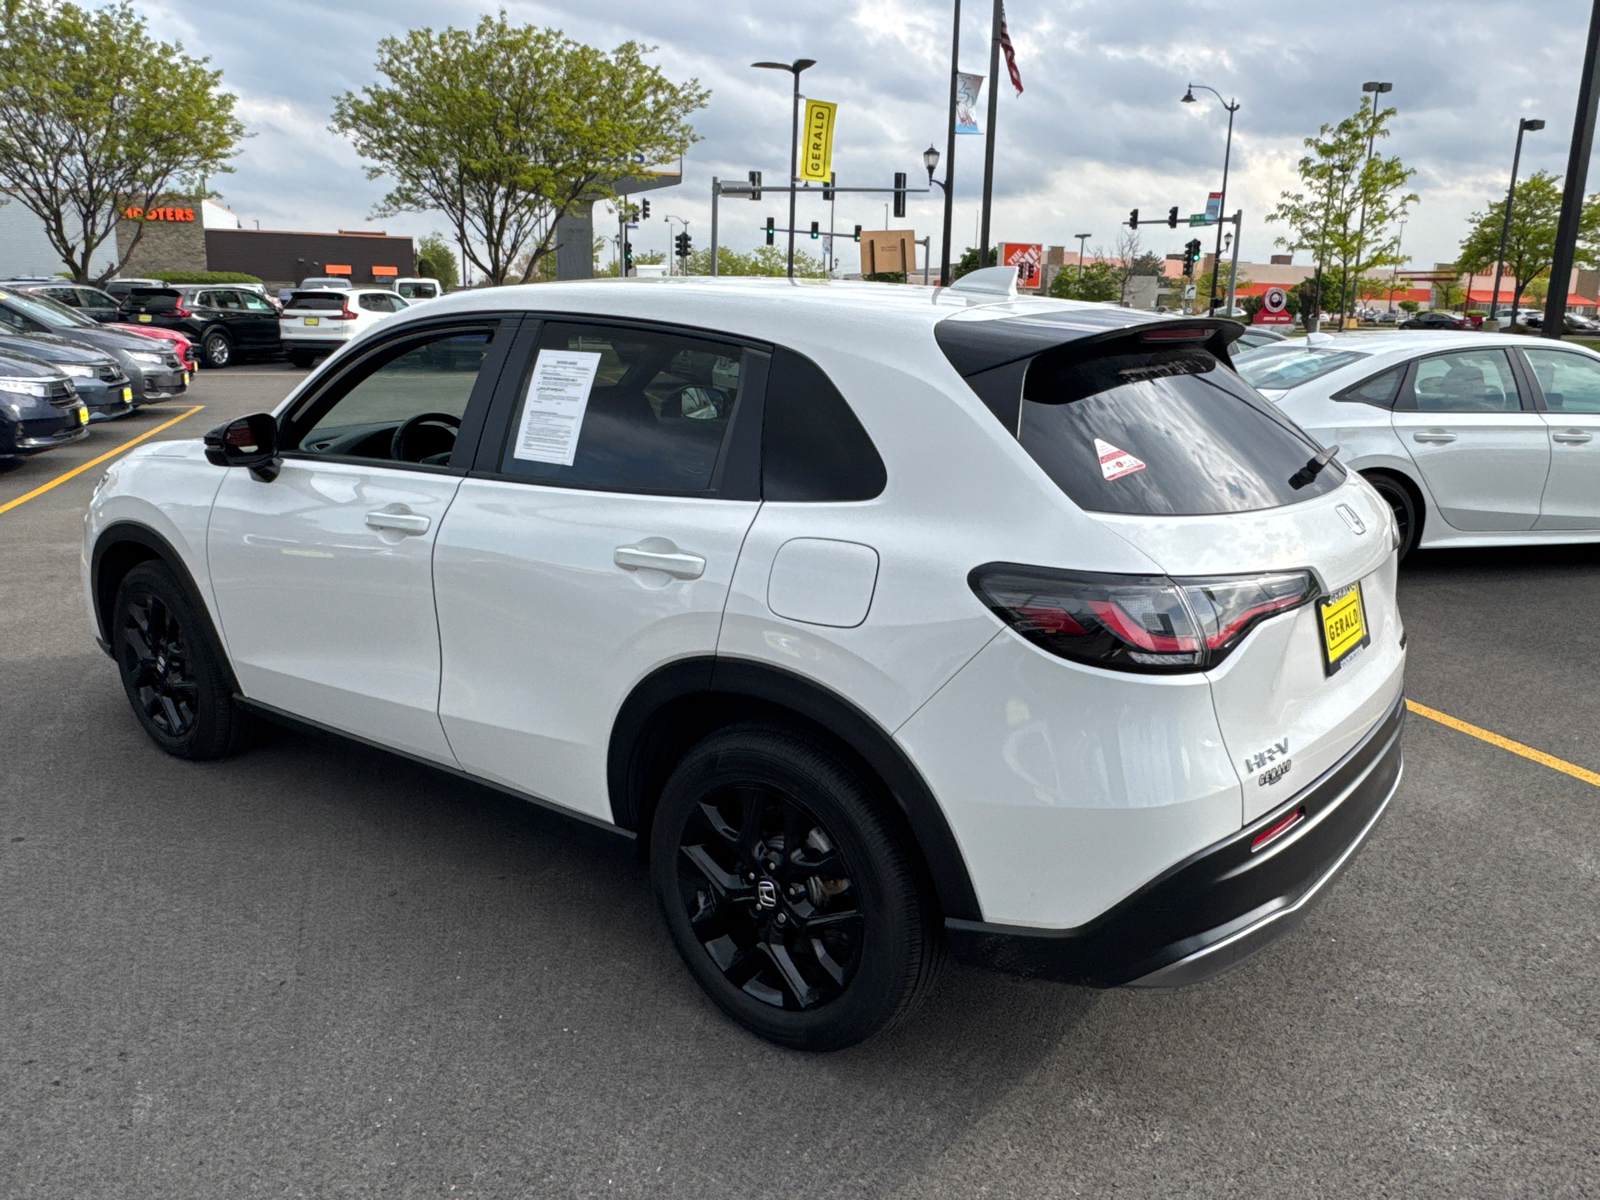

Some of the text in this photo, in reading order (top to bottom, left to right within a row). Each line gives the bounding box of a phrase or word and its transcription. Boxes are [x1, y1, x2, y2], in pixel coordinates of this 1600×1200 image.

[811, 111, 825, 172] GERALD
[1328, 608, 1359, 642] GERALD
[1258, 758, 1292, 787] GERALD
